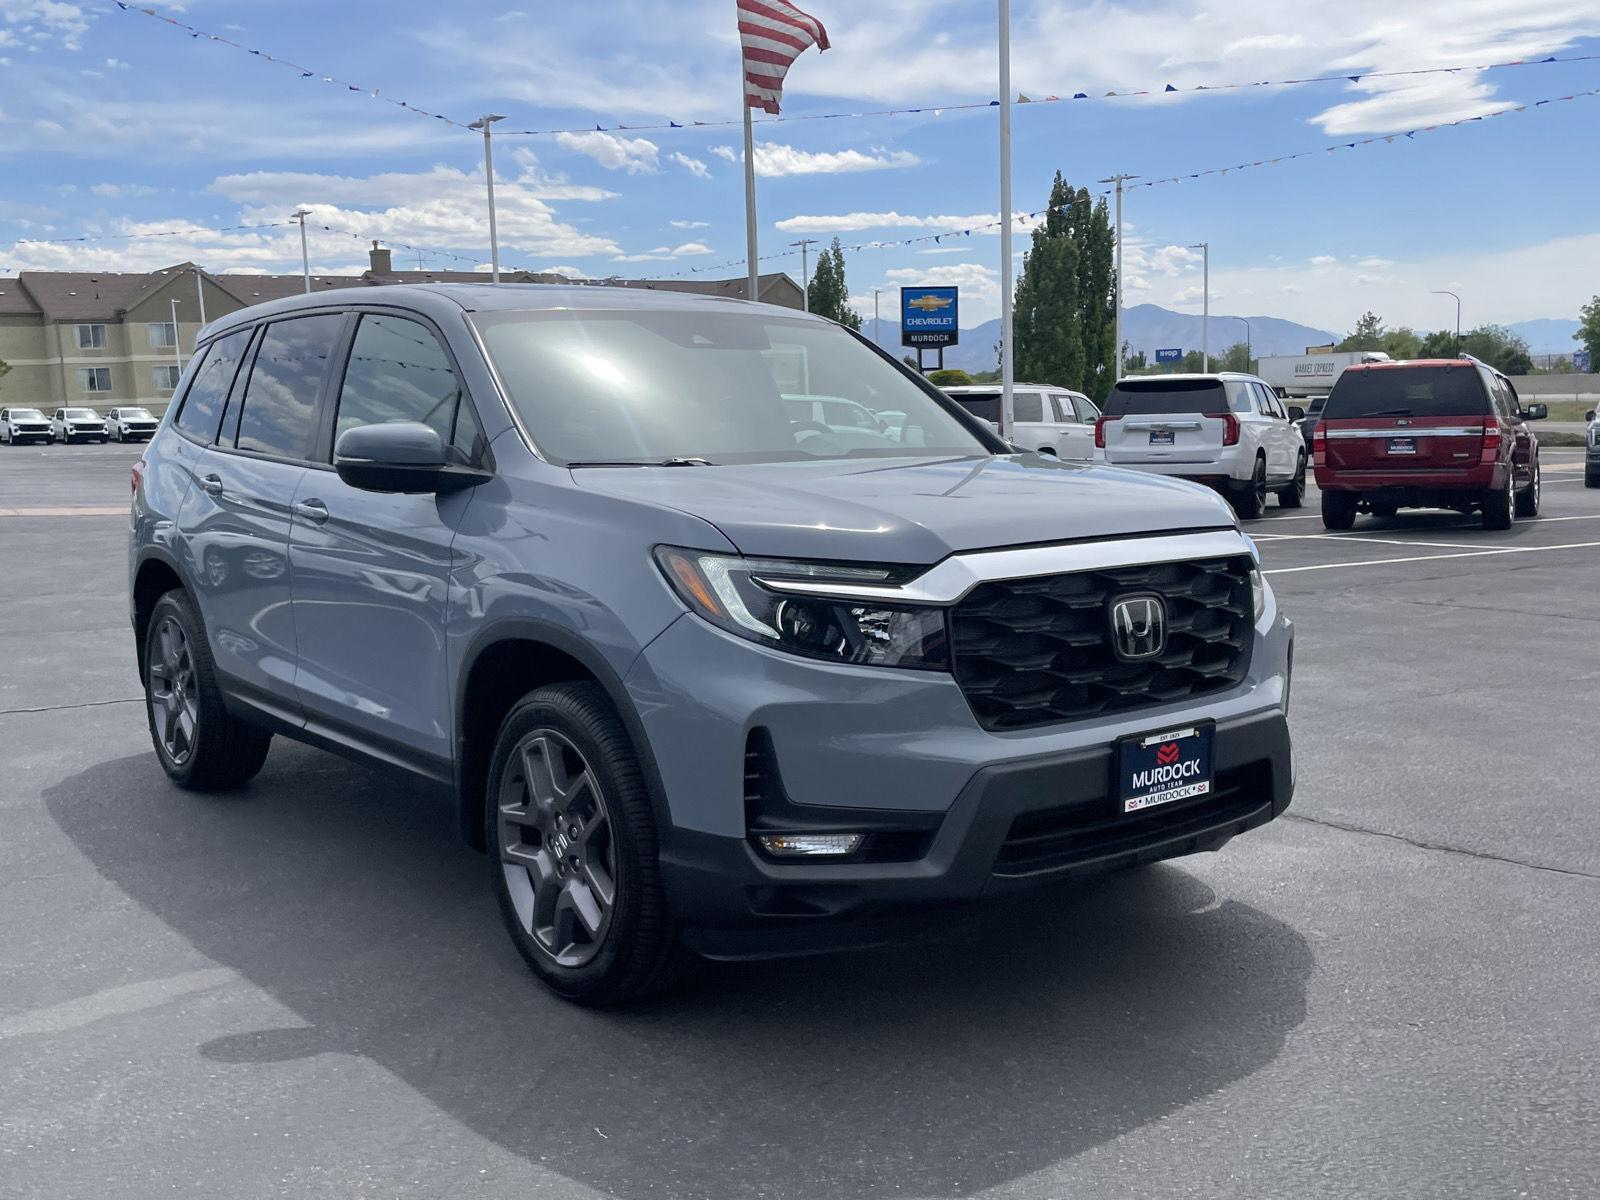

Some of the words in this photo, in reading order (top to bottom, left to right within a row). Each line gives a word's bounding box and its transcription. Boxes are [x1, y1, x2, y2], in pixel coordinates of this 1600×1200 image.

[1294, 363, 1312, 373] MARKET
[1314, 362, 1334, 373] EXPRESS
[1132, 758, 1200, 789] MURDOCK
[1149, 784, 1165, 793] AUTO
[1168, 779, 1183, 788] TEAM
[1145, 787, 1191, 806] MURDOCK
